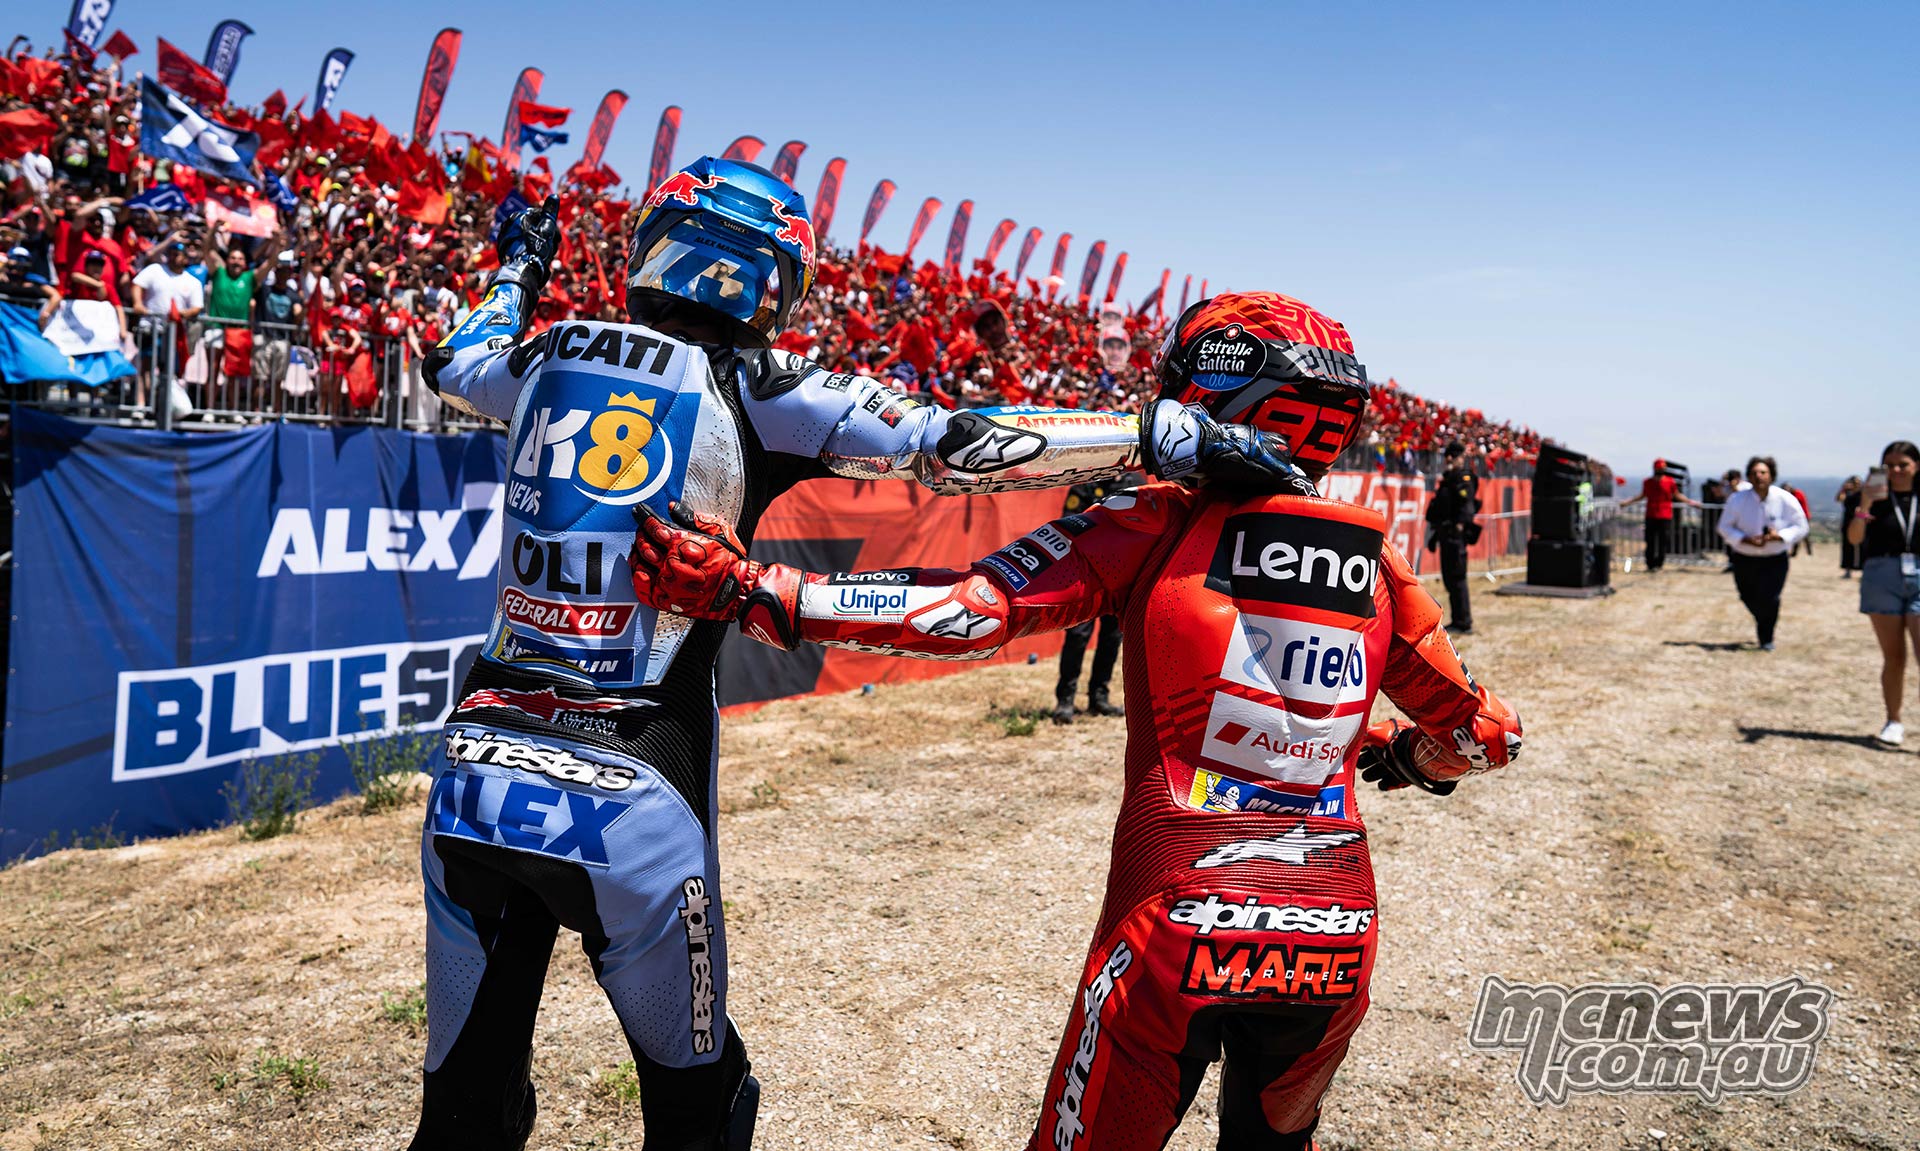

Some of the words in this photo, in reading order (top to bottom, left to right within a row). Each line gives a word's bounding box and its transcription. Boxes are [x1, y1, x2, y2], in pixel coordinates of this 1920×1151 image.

[694, 236, 717, 247] ALEX
[716, 243, 757, 264] MARQUEZ
[543, 324, 676, 376] UCATI
[1197, 354, 1246, 372] Galicia
[1199, 339, 1254, 357] Estrella
[507, 480, 542, 516] NEWS
[257, 483, 505, 581] ALEX7
[1032, 525, 1067, 553] ello
[512, 531, 603, 595] OLI
[835, 572, 910, 583] Lenovo
[505, 593, 570, 629] FEDERAL
[578, 610, 618, 630] OIL
[839, 587, 908, 616] Unipol
[1250, 731, 1315, 761] Audi
[426, 769, 634, 866] ALEX
[1167, 893, 1377, 936] alpinestars
[678, 876, 717, 1055] alpinestars
[1183, 942, 1363, 998] MARC
[1217, 965, 1345, 981] MARQUEZ
[1053, 940, 1133, 1151] alpinestars
